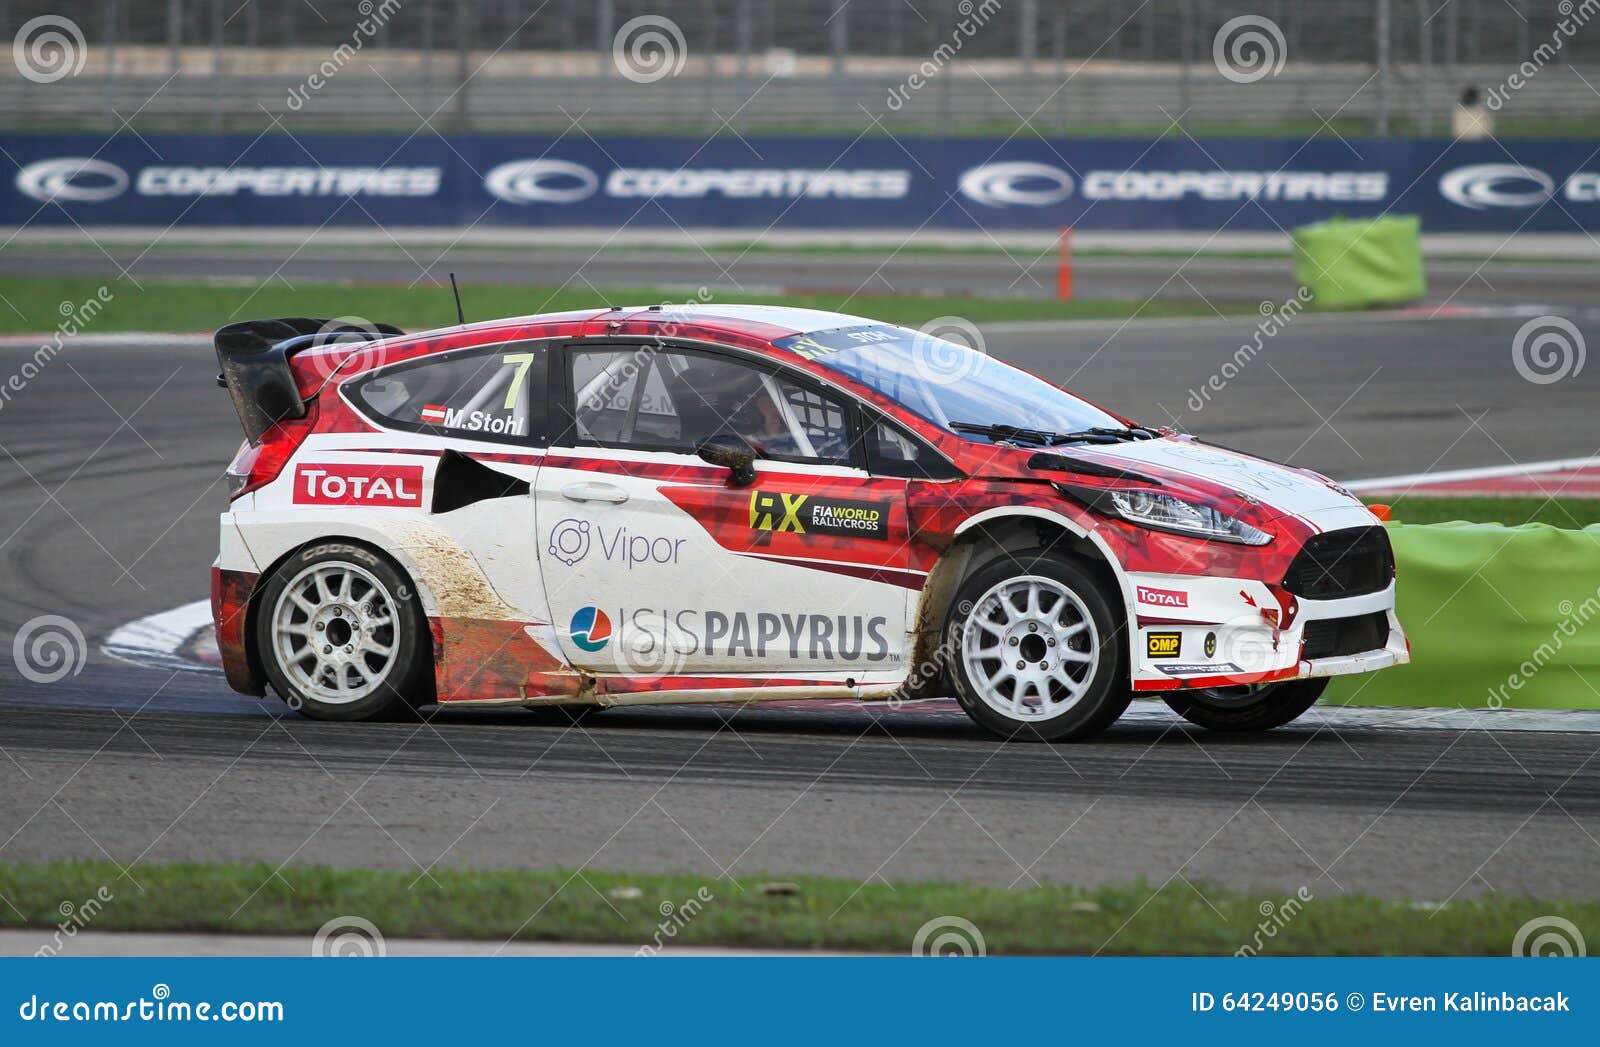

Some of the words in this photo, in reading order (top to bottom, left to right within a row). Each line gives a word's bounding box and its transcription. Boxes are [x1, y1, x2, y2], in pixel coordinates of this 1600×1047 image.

[503, 353, 534, 409] 7
[444, 408, 524, 436] M.Stohl
[812, 517, 879, 531] RALLYCROSS
[302, 544, 380, 566] COOPER
[597, 526, 687, 569] Vipor
[1149, 638, 1179, 651] OMP
